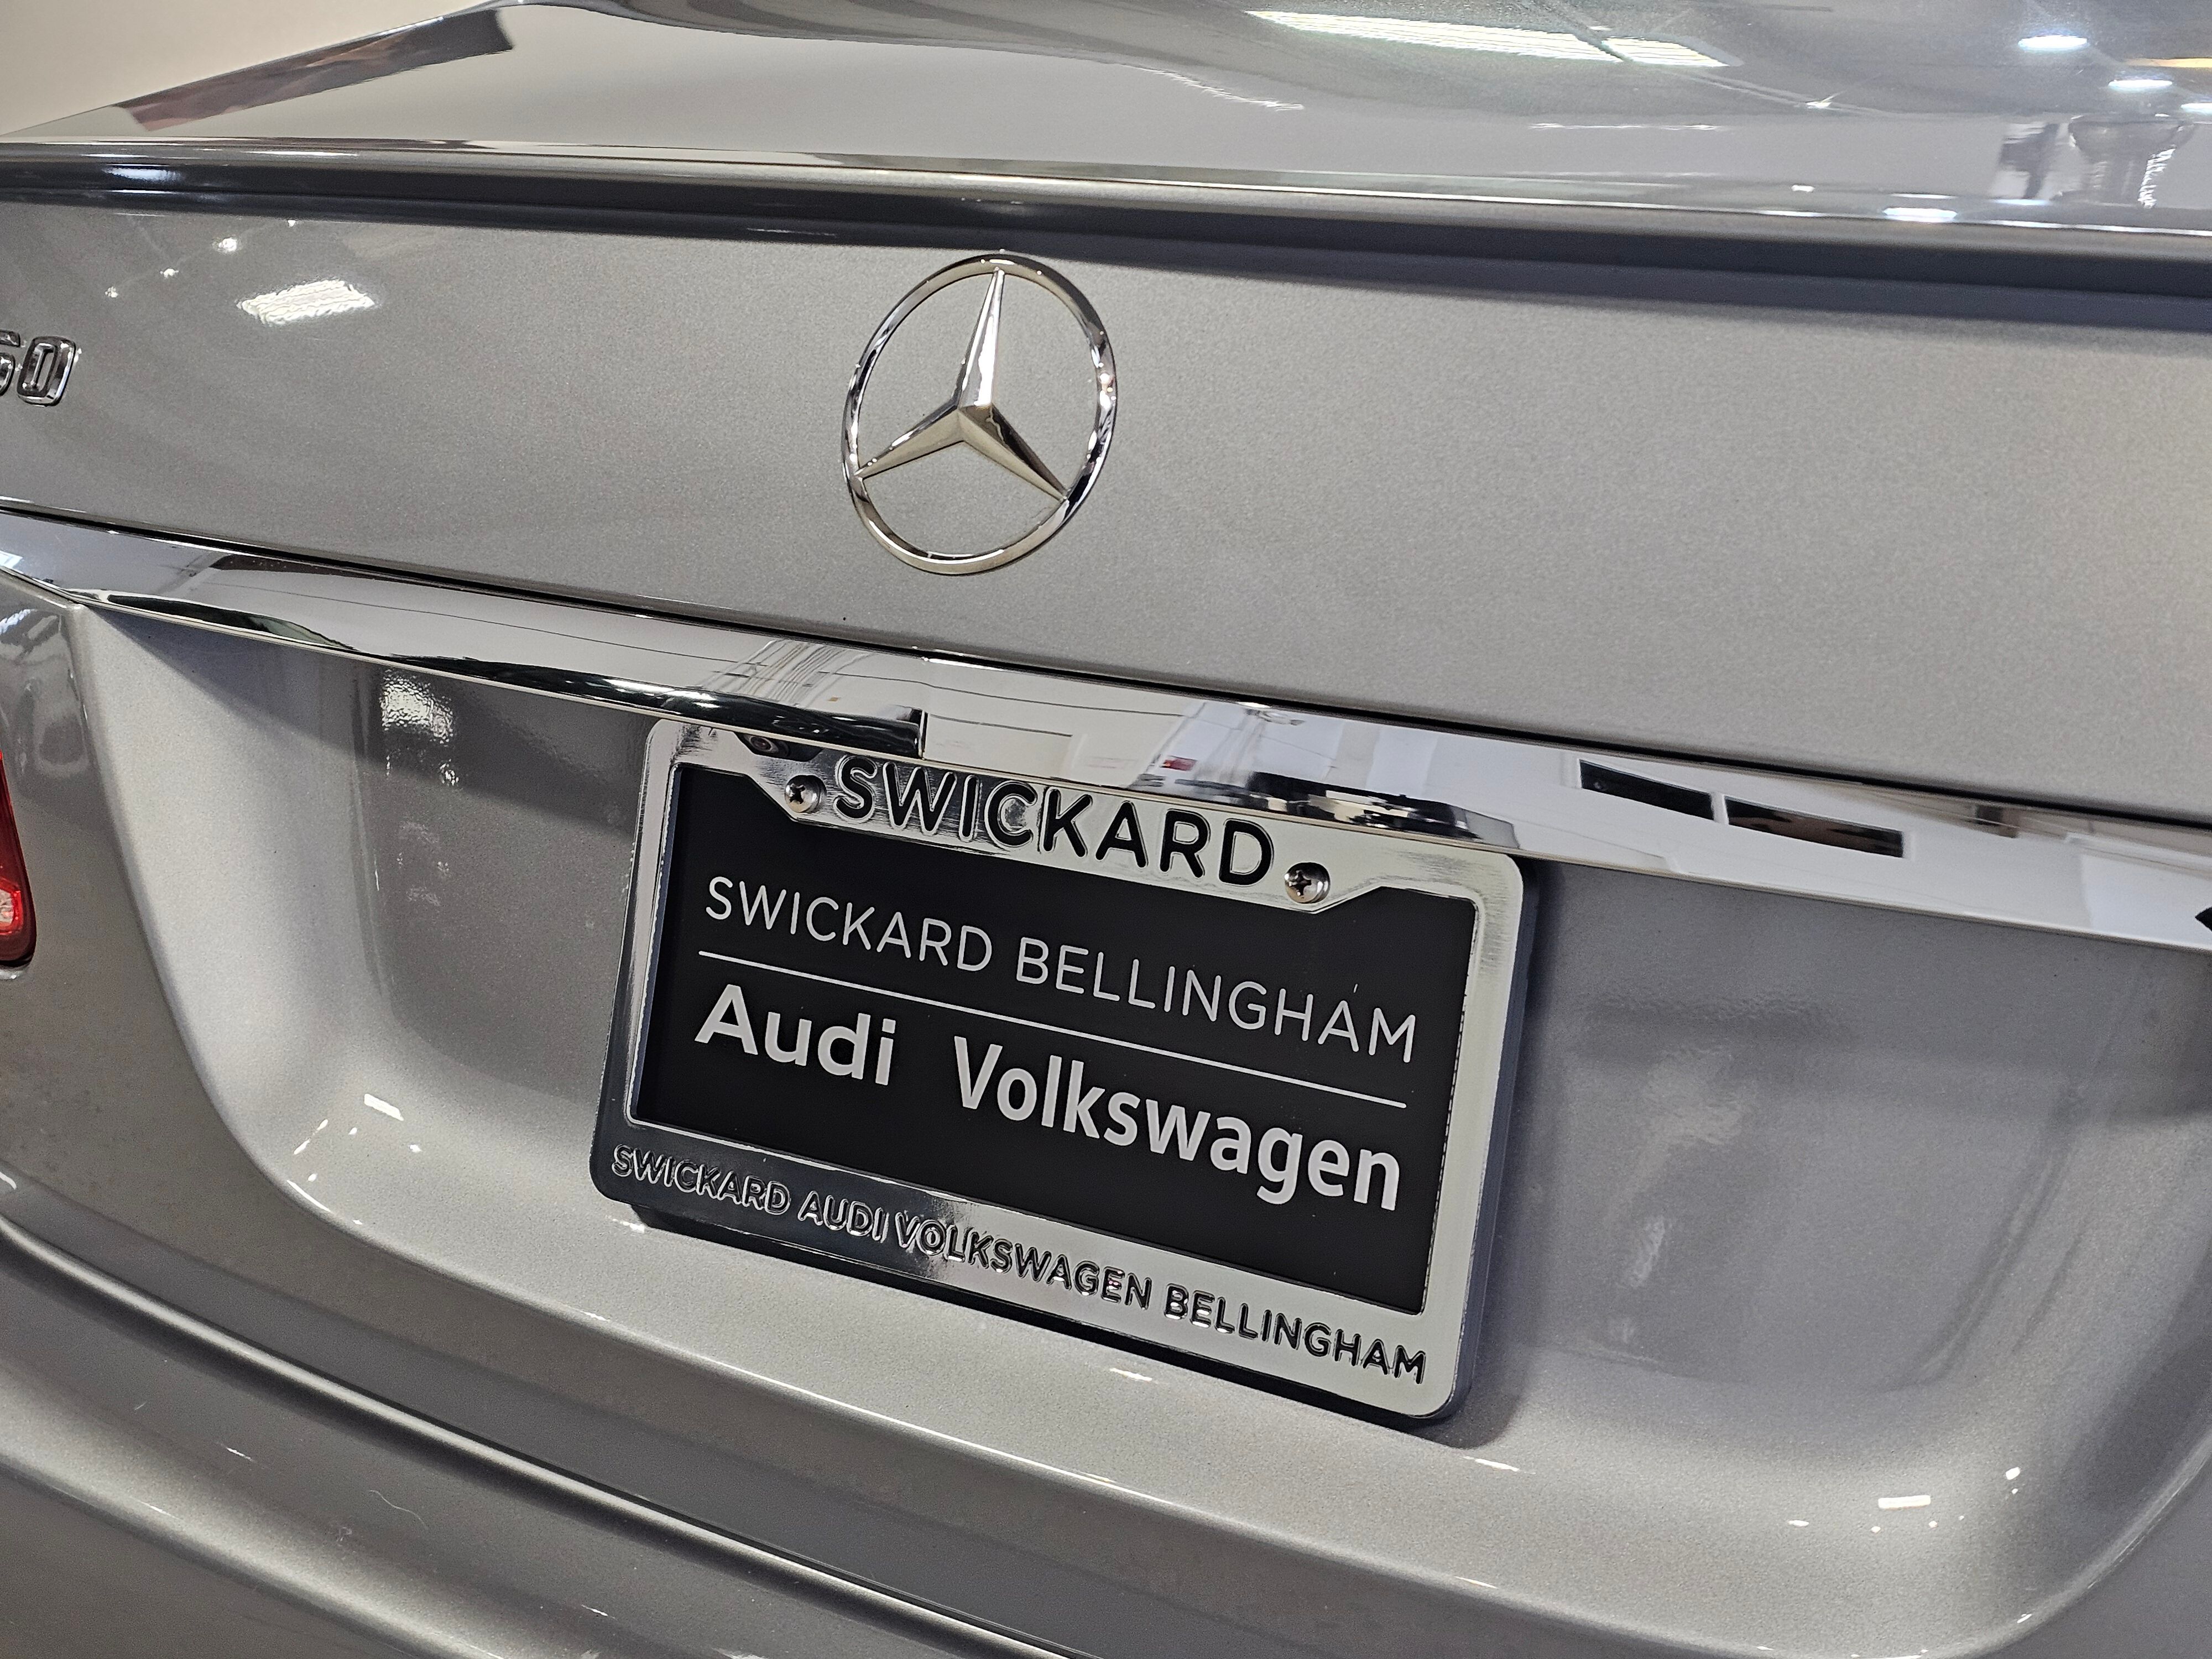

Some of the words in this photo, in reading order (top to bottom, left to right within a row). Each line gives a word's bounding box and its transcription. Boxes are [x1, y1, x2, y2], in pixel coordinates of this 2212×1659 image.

[834, 755, 1274, 886] SWICKARD
[706, 877, 992, 971] SWICKARD
[1016, 937, 1416, 1062] BELLINGHAM
[695, 984, 896, 1086] Audi
[954, 1036, 1400, 1211] Volkswagen
[612, 1144, 791, 1215] SWICKARD
[797, 1190, 889, 1242] AUDI
[895, 1211, 1152, 1310] VOLKSWAGEN
[1163, 1282, 1427, 1384] BELLINGHAM
